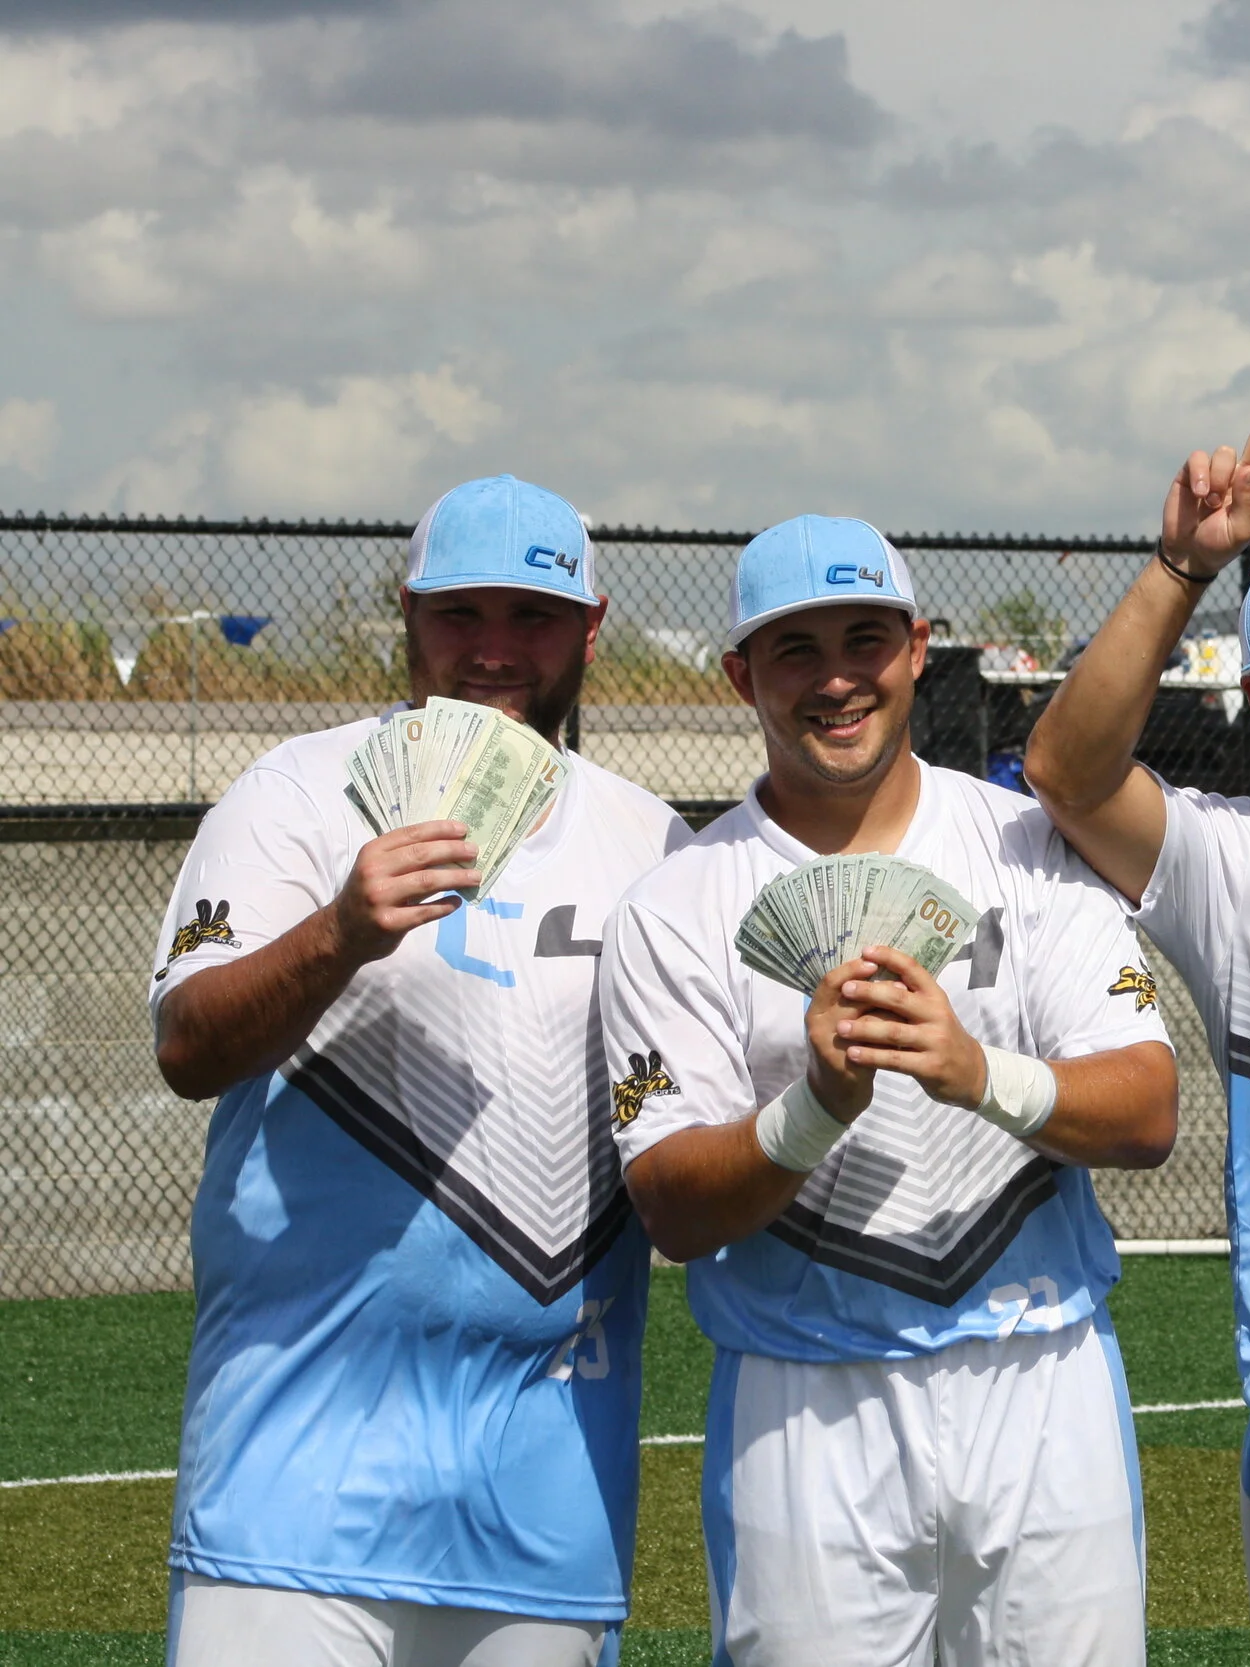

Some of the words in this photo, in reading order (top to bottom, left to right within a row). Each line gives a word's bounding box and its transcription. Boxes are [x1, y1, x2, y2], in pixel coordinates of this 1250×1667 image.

[525, 545, 578, 578] C4
[826, 564, 883, 588] C4
[919, 898, 959, 939] 100
